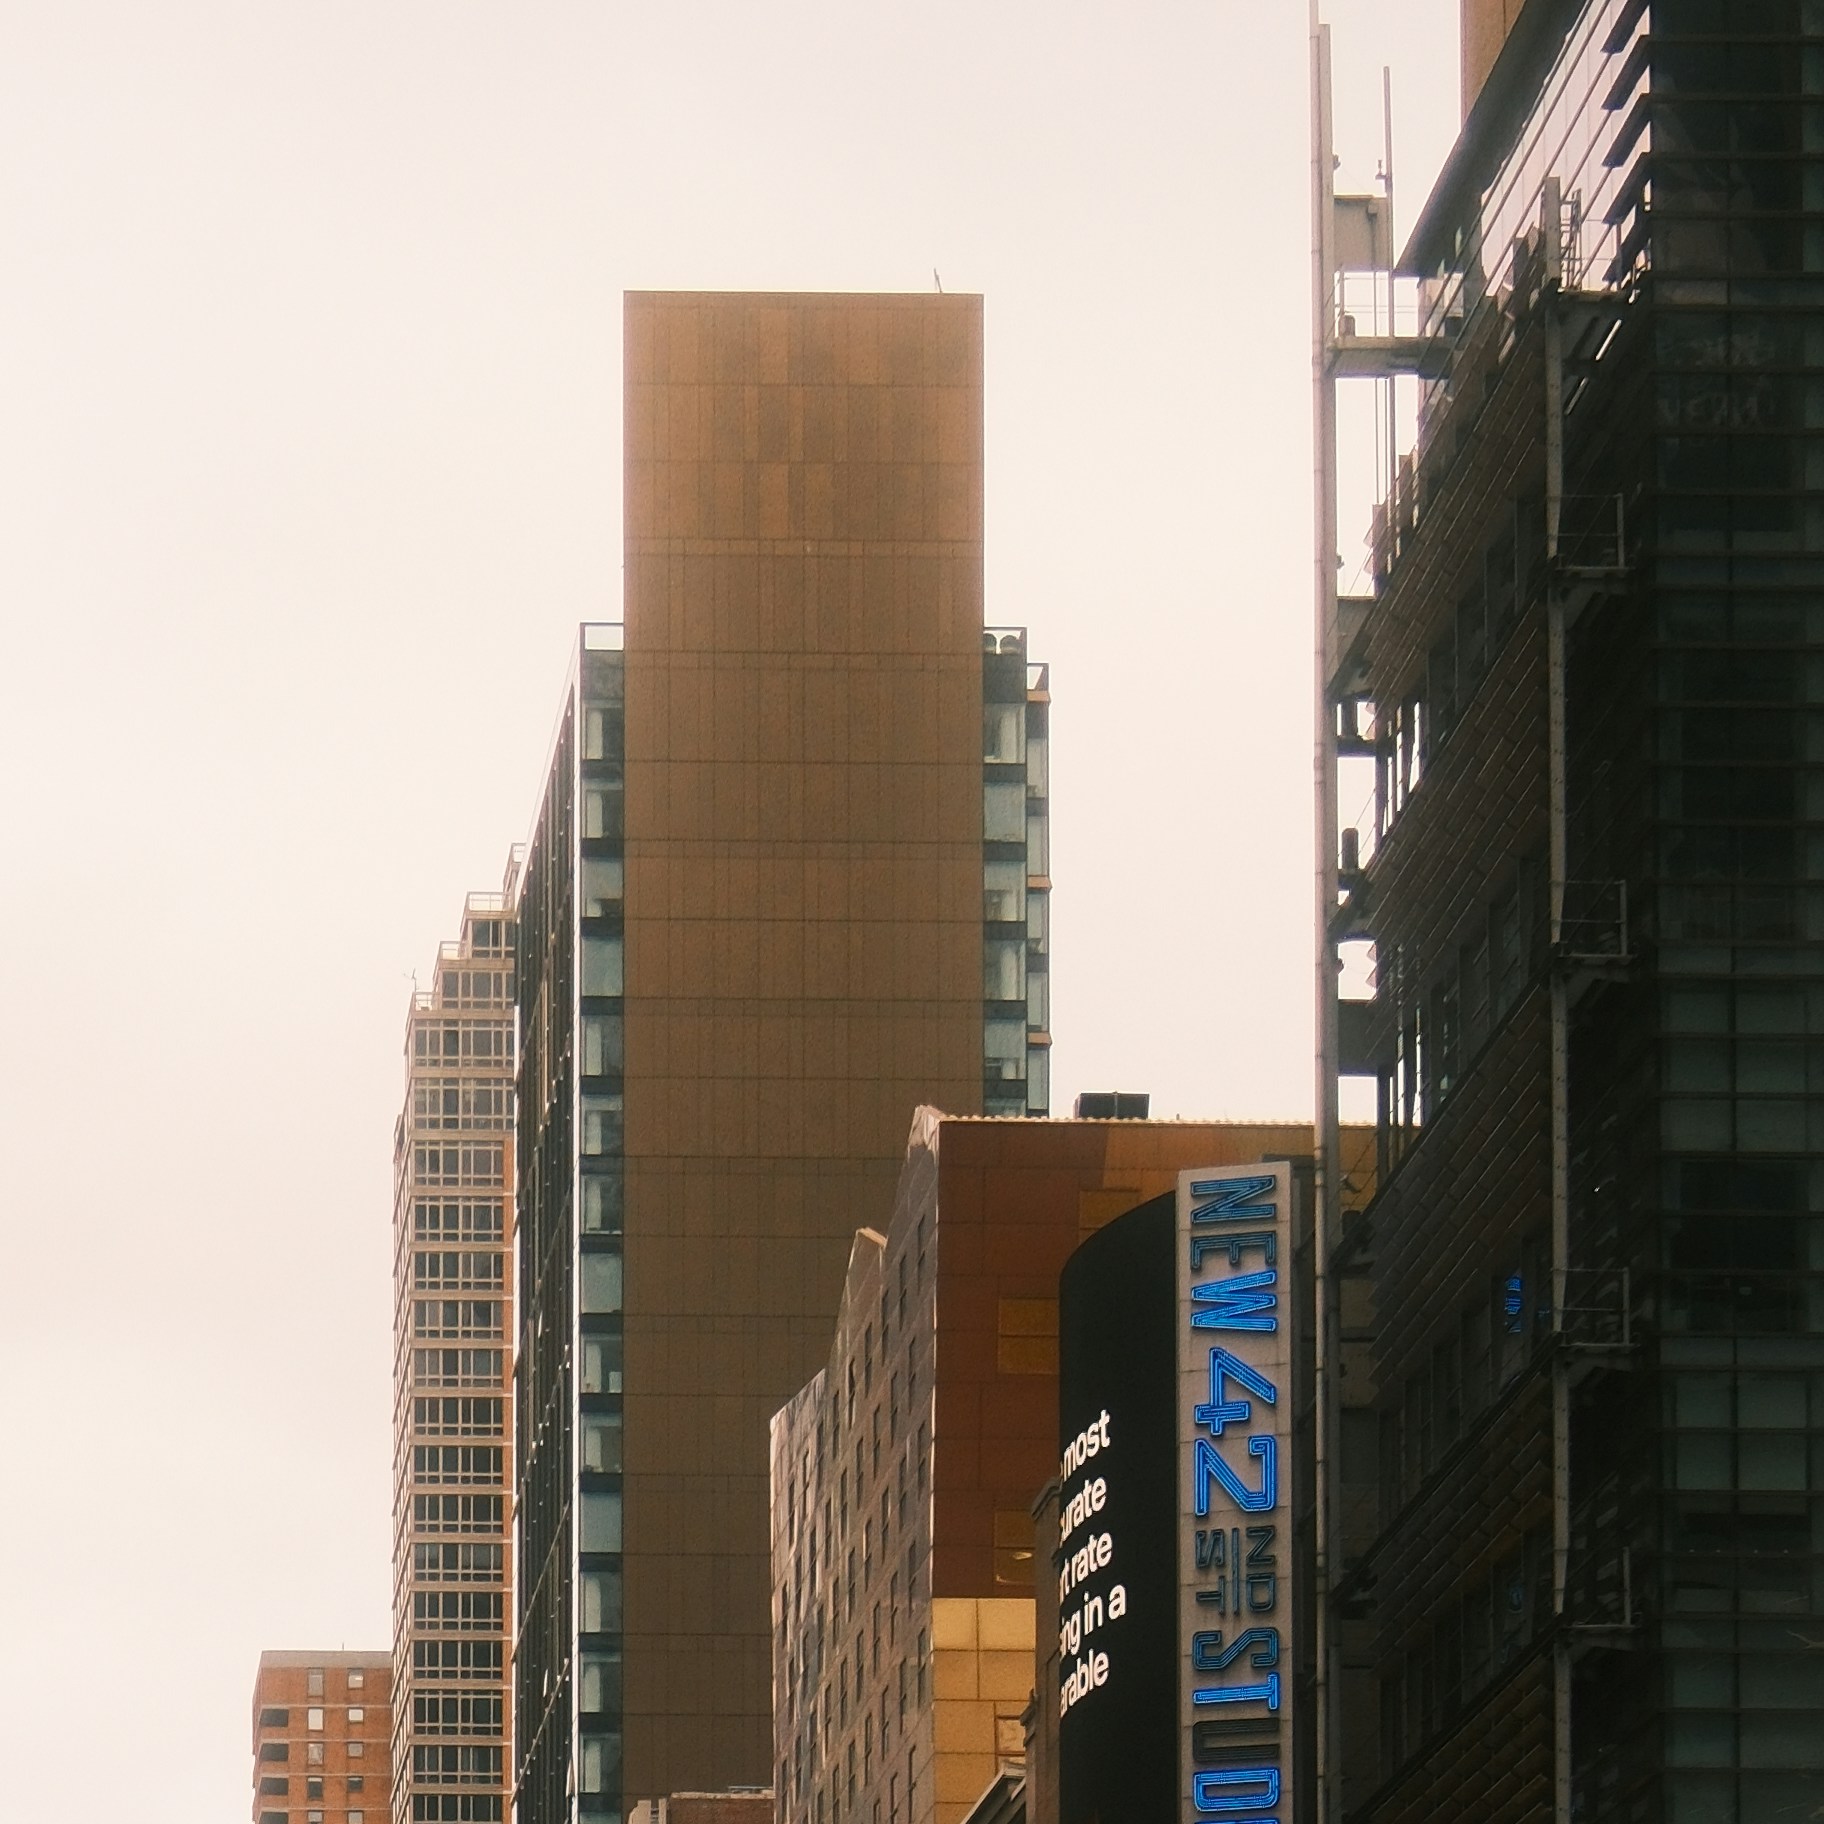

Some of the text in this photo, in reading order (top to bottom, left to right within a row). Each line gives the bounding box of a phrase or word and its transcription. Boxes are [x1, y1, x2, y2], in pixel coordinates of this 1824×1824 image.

[1190, 1174, 1279, 1517] NEW 42
[1063, 1409, 1110, 1482] most
[1071, 1532, 1113, 1582] rate
[1244, 1526, 1277, 1614] ND
[1083, 1592, 1104, 1634] in
[1108, 1584, 1127, 1621] a
